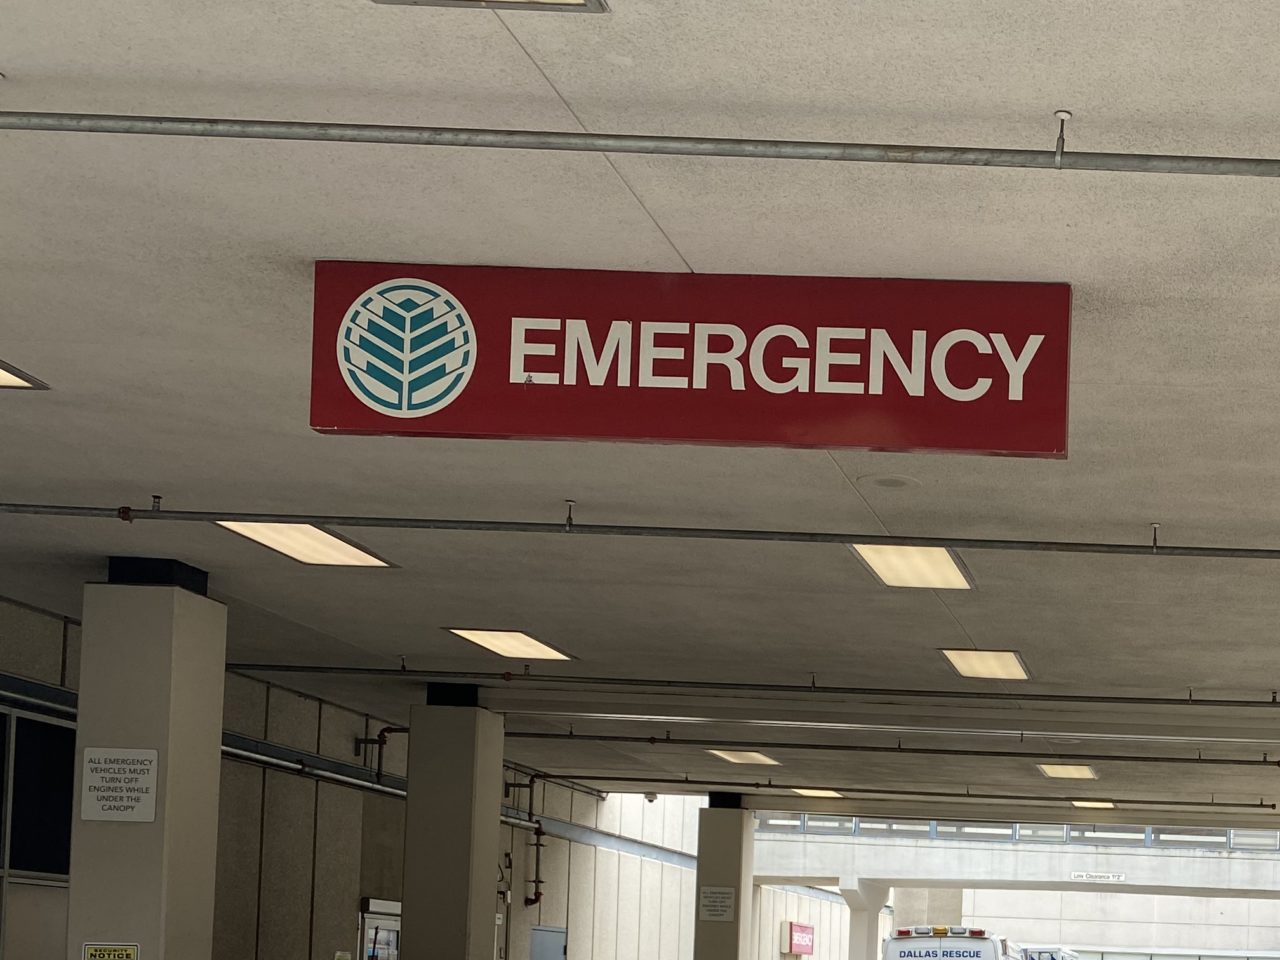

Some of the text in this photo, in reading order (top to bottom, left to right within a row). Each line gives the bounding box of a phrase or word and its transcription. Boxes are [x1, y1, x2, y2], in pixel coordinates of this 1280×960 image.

[508, 315, 1045, 403] EMERGENCY
[104, 758, 153, 766] EMERGENCY
[90, 767, 127, 775] VEHICLES
[102, 804, 135, 812] CANOPY
[941, 950, 982, 959] RESCUE
